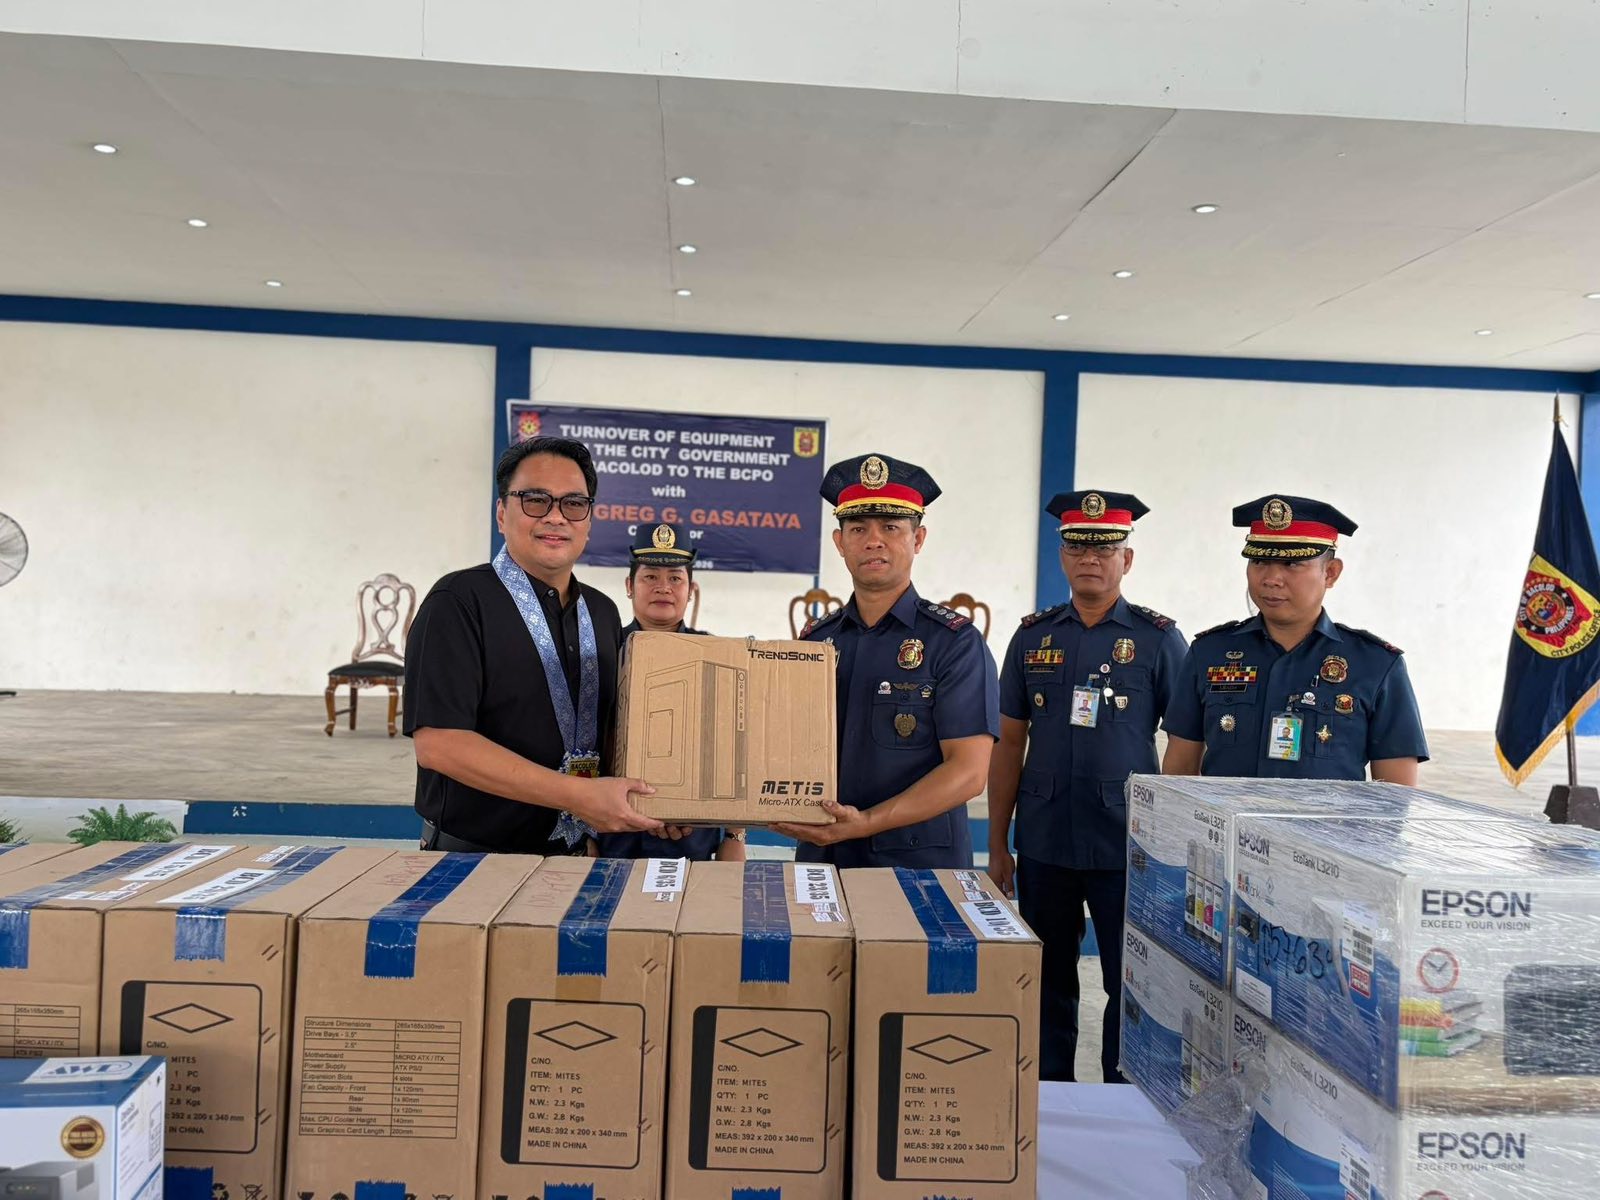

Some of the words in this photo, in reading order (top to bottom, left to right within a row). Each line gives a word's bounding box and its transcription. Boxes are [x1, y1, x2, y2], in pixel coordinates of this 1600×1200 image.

[560, 424, 650, 441] TURNOVER
[654, 430, 676, 442] OF
[680, 432, 775, 448] EQUIPMENT
[594, 444, 626, 456] THE
[632, 445, 670, 459] CITY
[678, 448, 790, 466] GOVERNMENT
[668, 464, 688, 477] TO
[694, 466, 726, 479] THE
[730, 468, 774, 482] BCPO
[652, 485, 686, 498] with
[594, 504, 654, 521] GREG
[662, 506, 683, 522] G.
[691, 506, 801, 530] GASATAYA
[1526, 583, 1556, 596] BACOLOD
[1545, 606, 1574, 634] PHILIPPINES
[1551, 648, 1569, 656] CITY
[1570, 632, 1594, 652] POLICE
[759, 798, 801, 808] Micro-ATX
[1133, 784, 1154, 806] EPSON
[1238, 829, 1270, 858] EPSON
[806, 868, 826, 881] BCD
[1316, 858, 1340, 878] L3210
[974, 902, 1002, 915] BCD
[1422, 889, 1531, 918] EPSON
[1421, 920, 1462, 929] EXCEED
[1466, 921, 1494, 930] YOUR
[1497, 922, 1531, 931] VISION
[1126, 932, 1148, 960] EPSON
[1234, 1014, 1266, 1053] EPSON
[146, 1041, 169, 1049] C/NO.
[325, 1062, 346, 1070] Supply
[1314, 1072, 1338, 1100] L3210
[570, 1114, 584, 1122] Kgs
[1418, 1132, 1526, 1160] EPSON
[1462, 1163, 1488, 1171] YOUR
